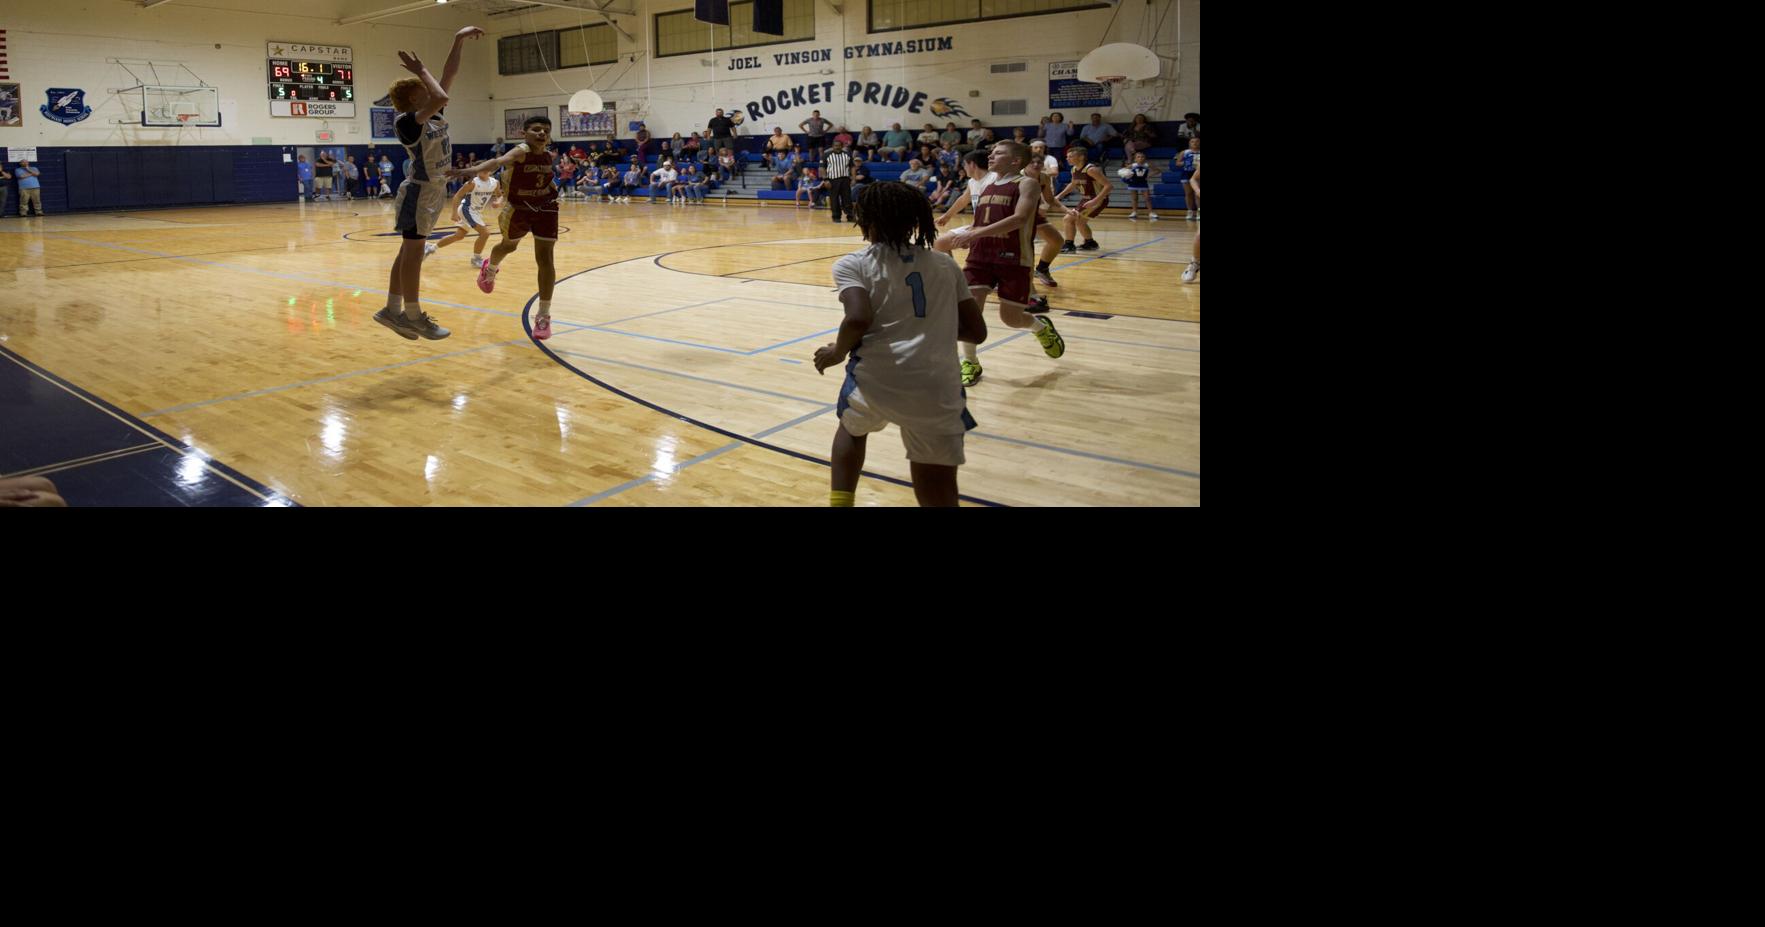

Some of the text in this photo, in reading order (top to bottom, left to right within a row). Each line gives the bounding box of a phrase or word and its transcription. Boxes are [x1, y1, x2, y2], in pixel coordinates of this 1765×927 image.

[291, 45, 347, 54] CAPSTAR
[728, 36, 953, 70] JOEL VINSON GYMNASIUM
[275, 66, 351, 80] 69 71
[317, 76, 324, 84] 4
[278, 88, 285, 96] 5
[345, 89, 352, 98] 5
[746, 80, 928, 122] ROCKET PRIDE
[536, 174, 544, 188] 3
[983, 206, 990, 224] 1
[904, 271, 927, 318] 1
